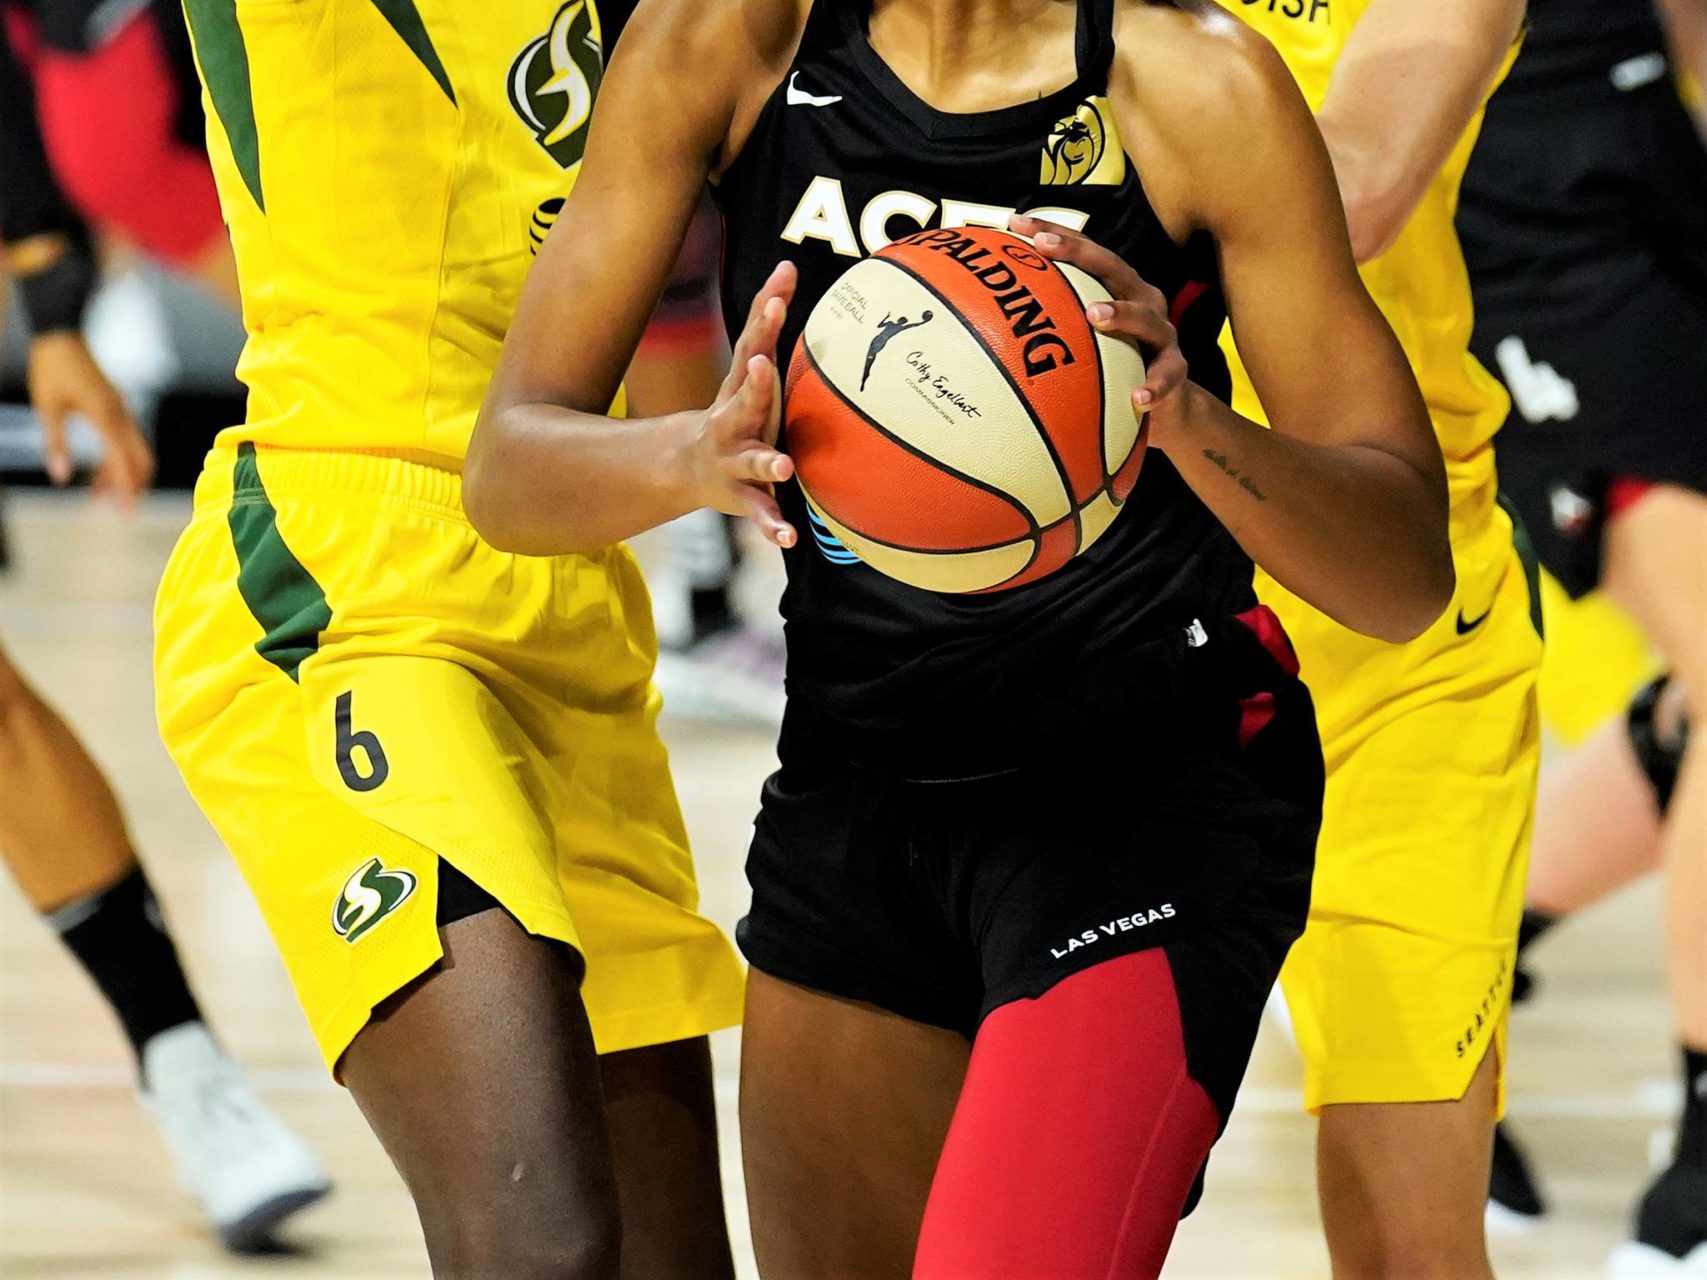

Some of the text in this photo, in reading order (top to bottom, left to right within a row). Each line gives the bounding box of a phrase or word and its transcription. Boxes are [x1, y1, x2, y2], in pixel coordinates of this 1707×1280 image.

[335, 690, 389, 792] 6
[1050, 903, 1176, 959] LAS VEGAS
